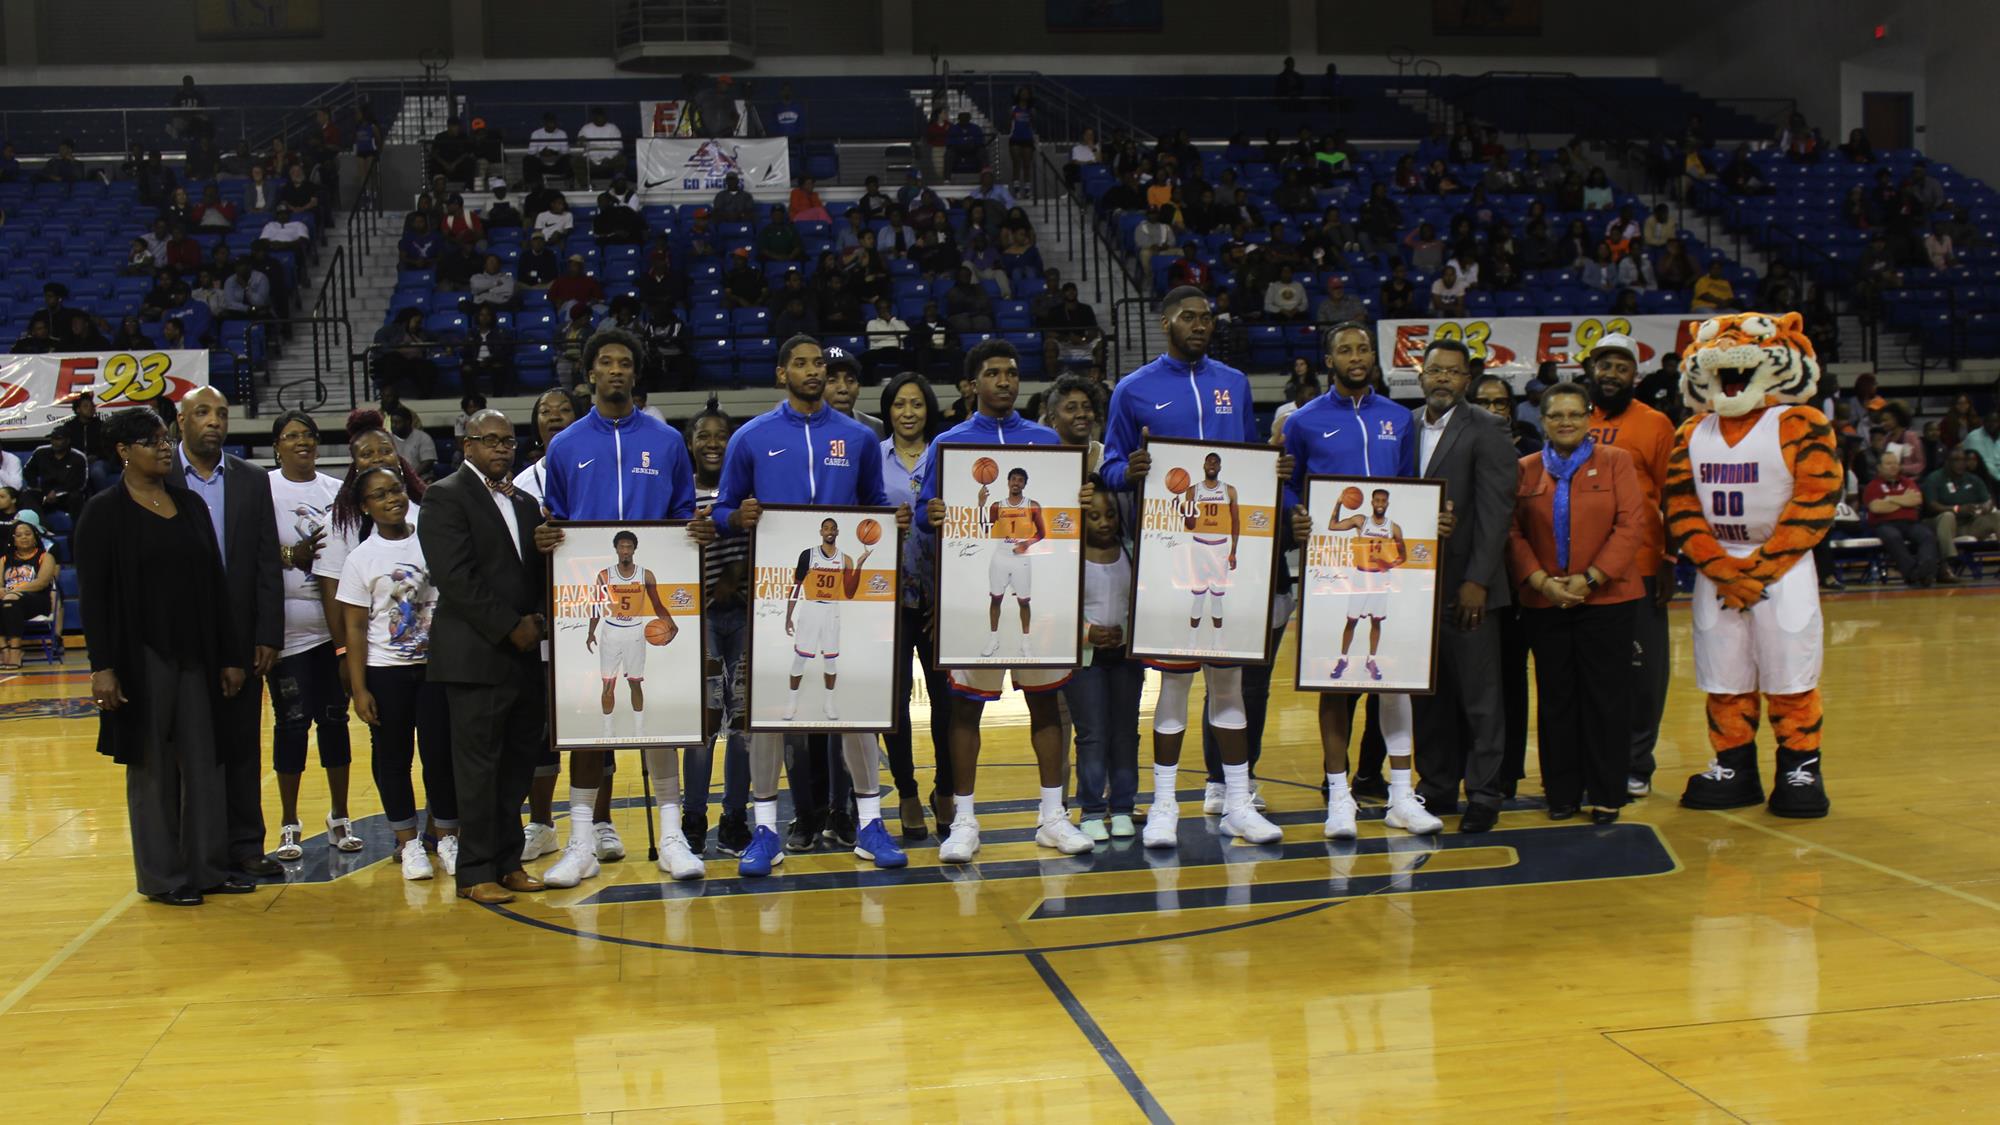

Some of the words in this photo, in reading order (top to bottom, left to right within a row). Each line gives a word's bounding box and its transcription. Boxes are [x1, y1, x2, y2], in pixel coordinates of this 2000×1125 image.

[683, 178, 700, 190] GO
[704, 177, 745, 190] TIGS
[54, 352, 171, 403] E93
[1213, 389, 1231, 406] 34
[1379, 420, 1393, 435] 14
[830, 440, 846, 457] 30
[641, 451, 650, 468] 5
[824, 457, 850, 467] CABEZA
[631, 467, 659, 475] JENKINS
[1700, 462, 1759, 484] SAVANNAH
[1144, 498, 1201, 518] MARICUS
[1204, 503, 1218, 517] 10
[1713, 491, 1744, 517] 00
[944, 506, 991, 523] AUSTIN
[943, 522, 994, 539] DASENT
[1011, 520, 1017, 534] 1
[1143, 515, 1186, 533] GLENN
[756, 567, 796, 584] JAHIR
[816, 574, 835, 589] 30
[555, 584, 609, 602] JAVARIS
[756, 584, 807, 600] CABEZA
[554, 602, 612, 618] JENKINS
[620, 596, 631, 611] 5
